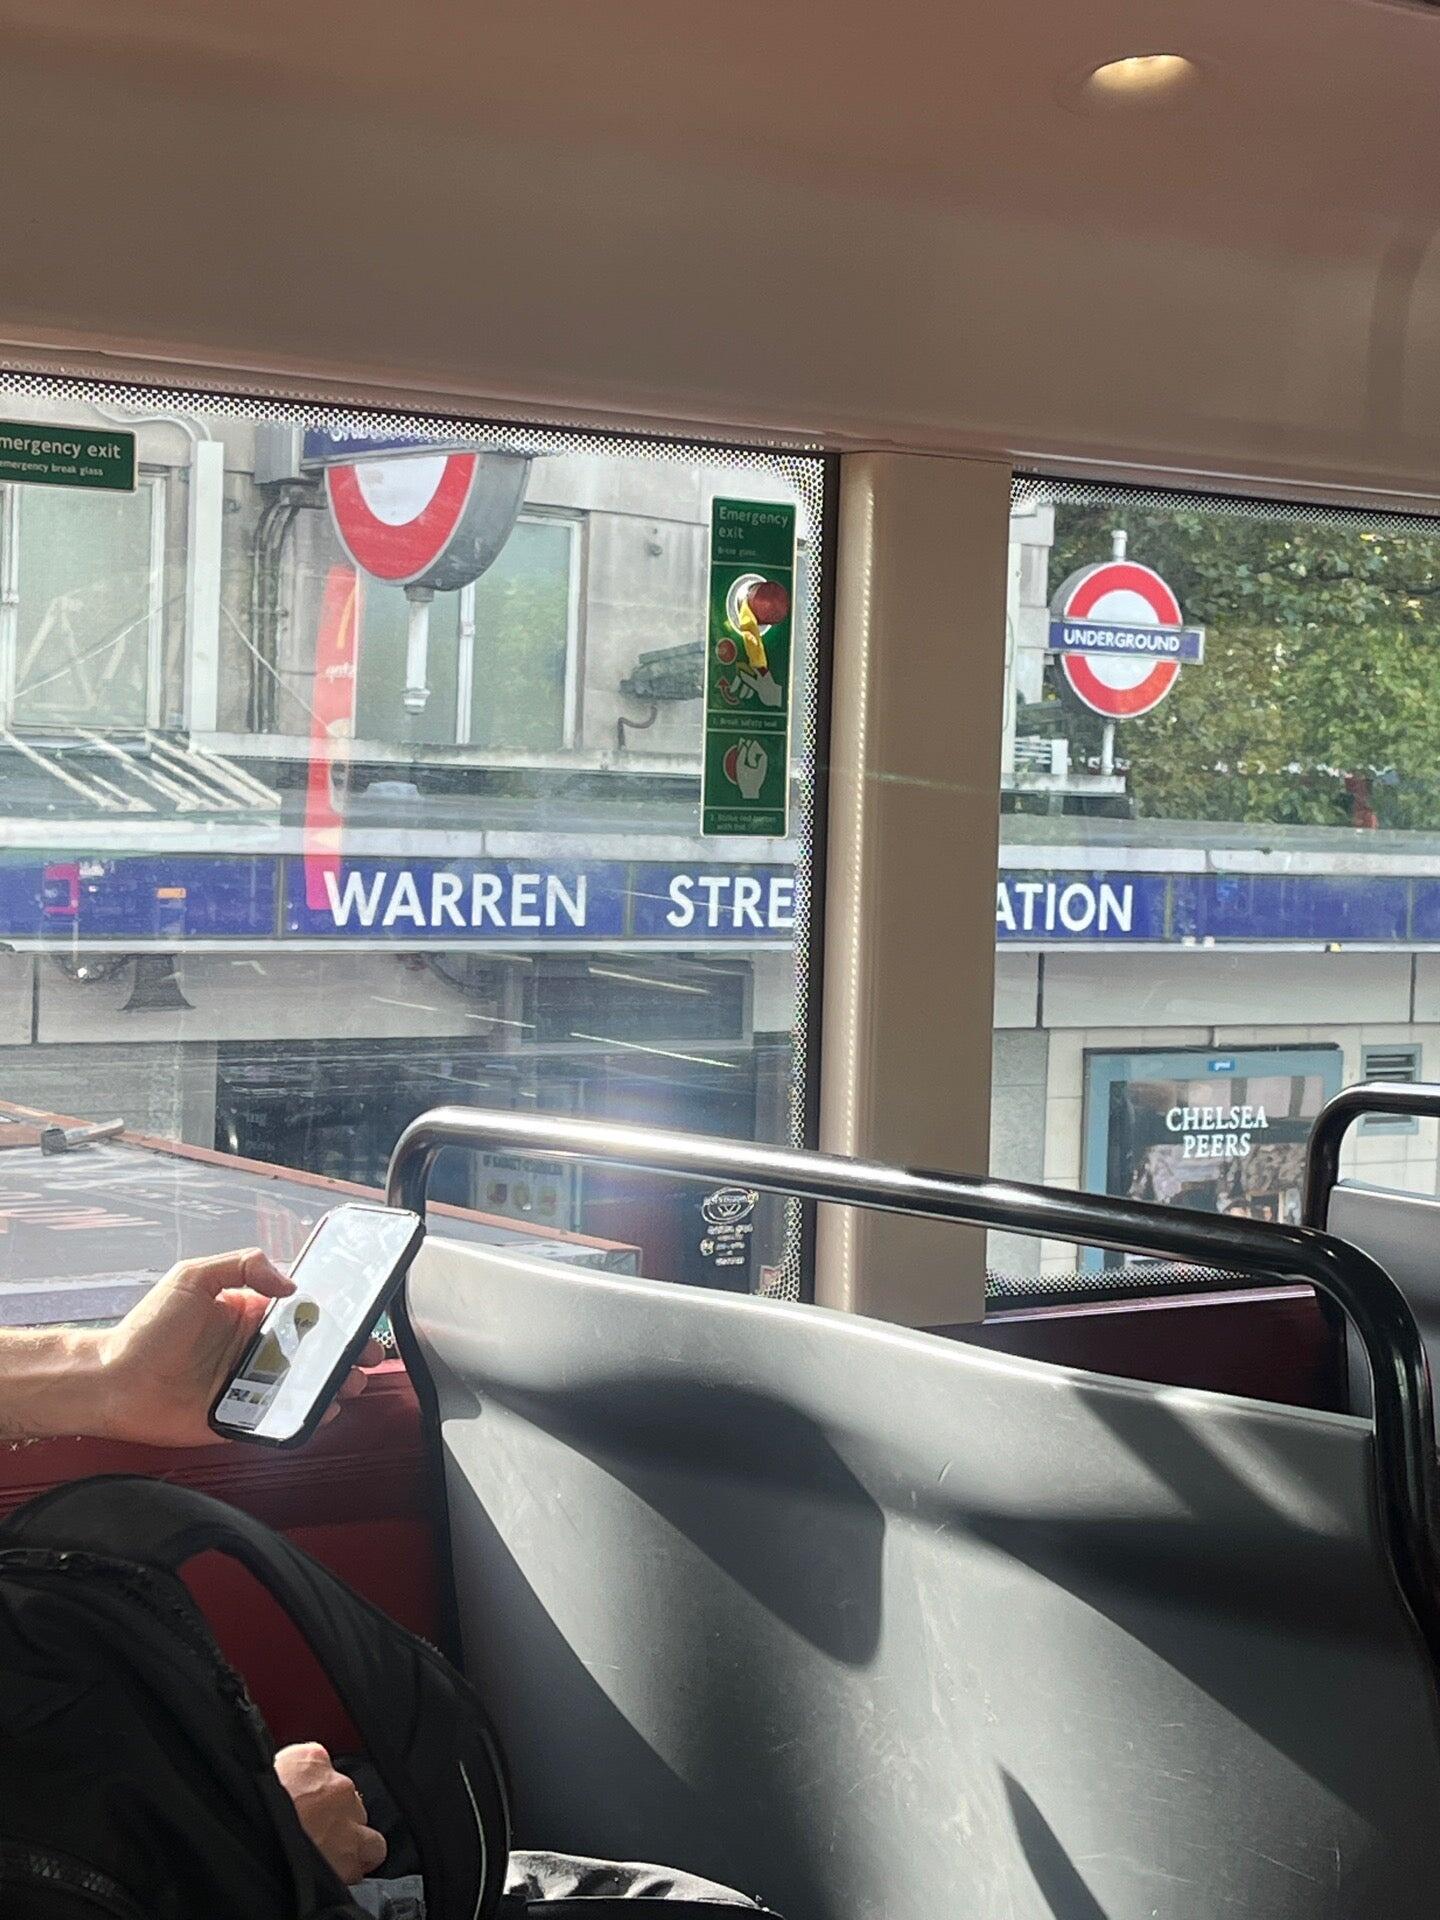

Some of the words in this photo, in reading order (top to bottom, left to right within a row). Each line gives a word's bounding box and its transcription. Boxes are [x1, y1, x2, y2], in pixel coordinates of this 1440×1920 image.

[0, 437, 81, 459] mergency
[87, 443, 121, 459] exit
[51, 463, 76, 474] break
[79, 466, 103, 476] glass
[719, 506, 789, 528] Emergency
[718, 526, 745, 539] exit
[1063, 628, 1180, 652] UNDERGROUND
[324, 871, 586, 927] WARREN
[666, 874, 796, 928] STRE
[1166, 1105, 1269, 1132] CHELSEA
[1182, 1133, 1251, 1159] PEERS
